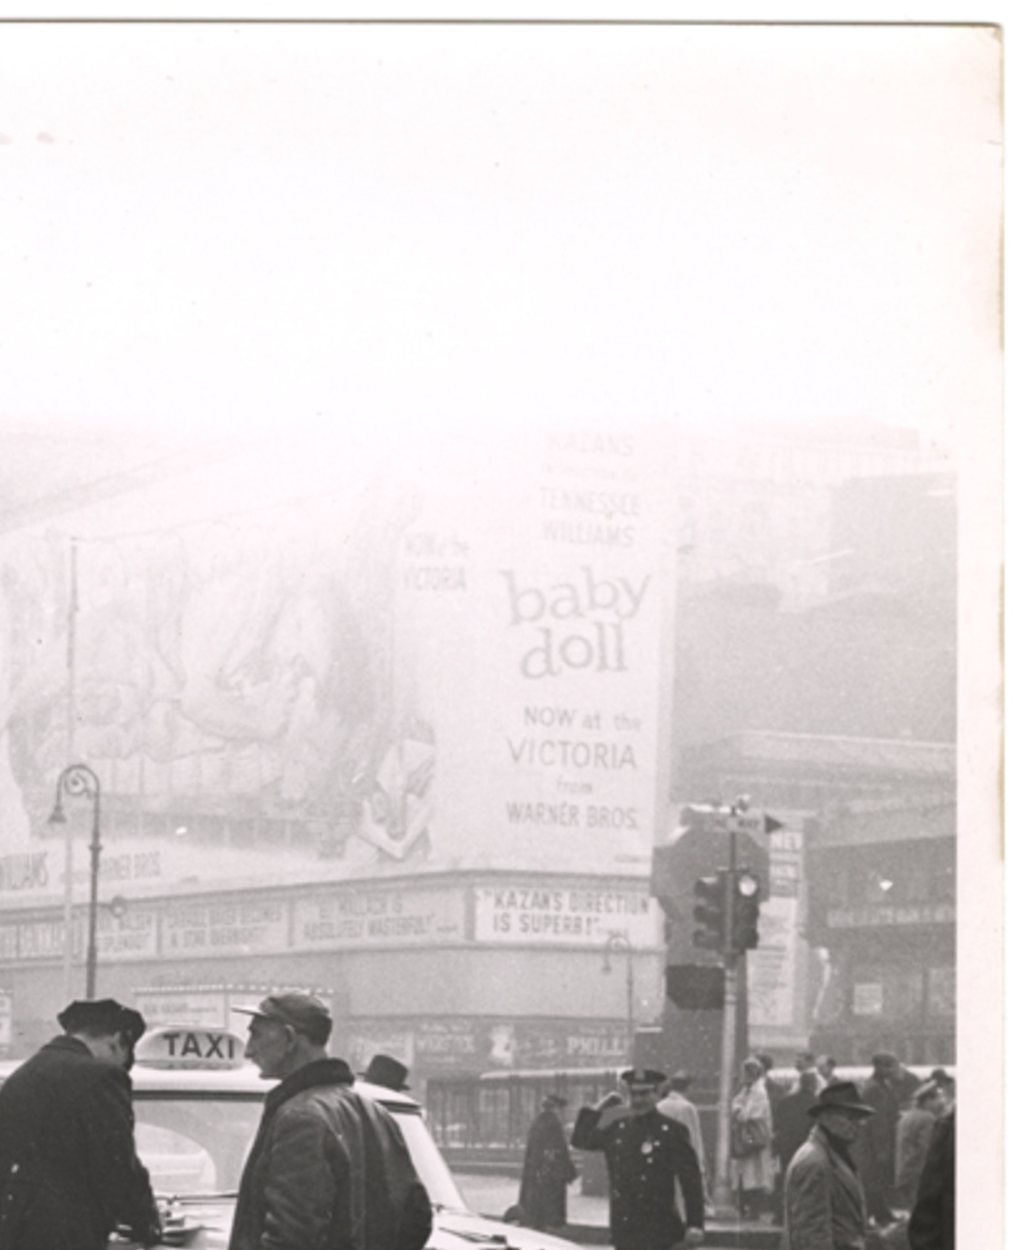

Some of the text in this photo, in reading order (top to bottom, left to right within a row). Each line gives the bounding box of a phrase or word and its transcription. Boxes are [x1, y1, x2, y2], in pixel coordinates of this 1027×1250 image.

[540, 485, 641, 518] TENNESSEE
[498, 564, 652, 628] baby
[519, 619, 630, 680] doll
[524, 705, 643, 732] NOW at the
[506, 736, 638, 770] VICTORIA
[556, 774, 593, 796] from
[506, 801, 581, 828] WARNER
[493, 912, 512, 934] IS
[162, 1032, 235, 1060] TAXI
[567, 1034, 630, 1056] PHILLI
